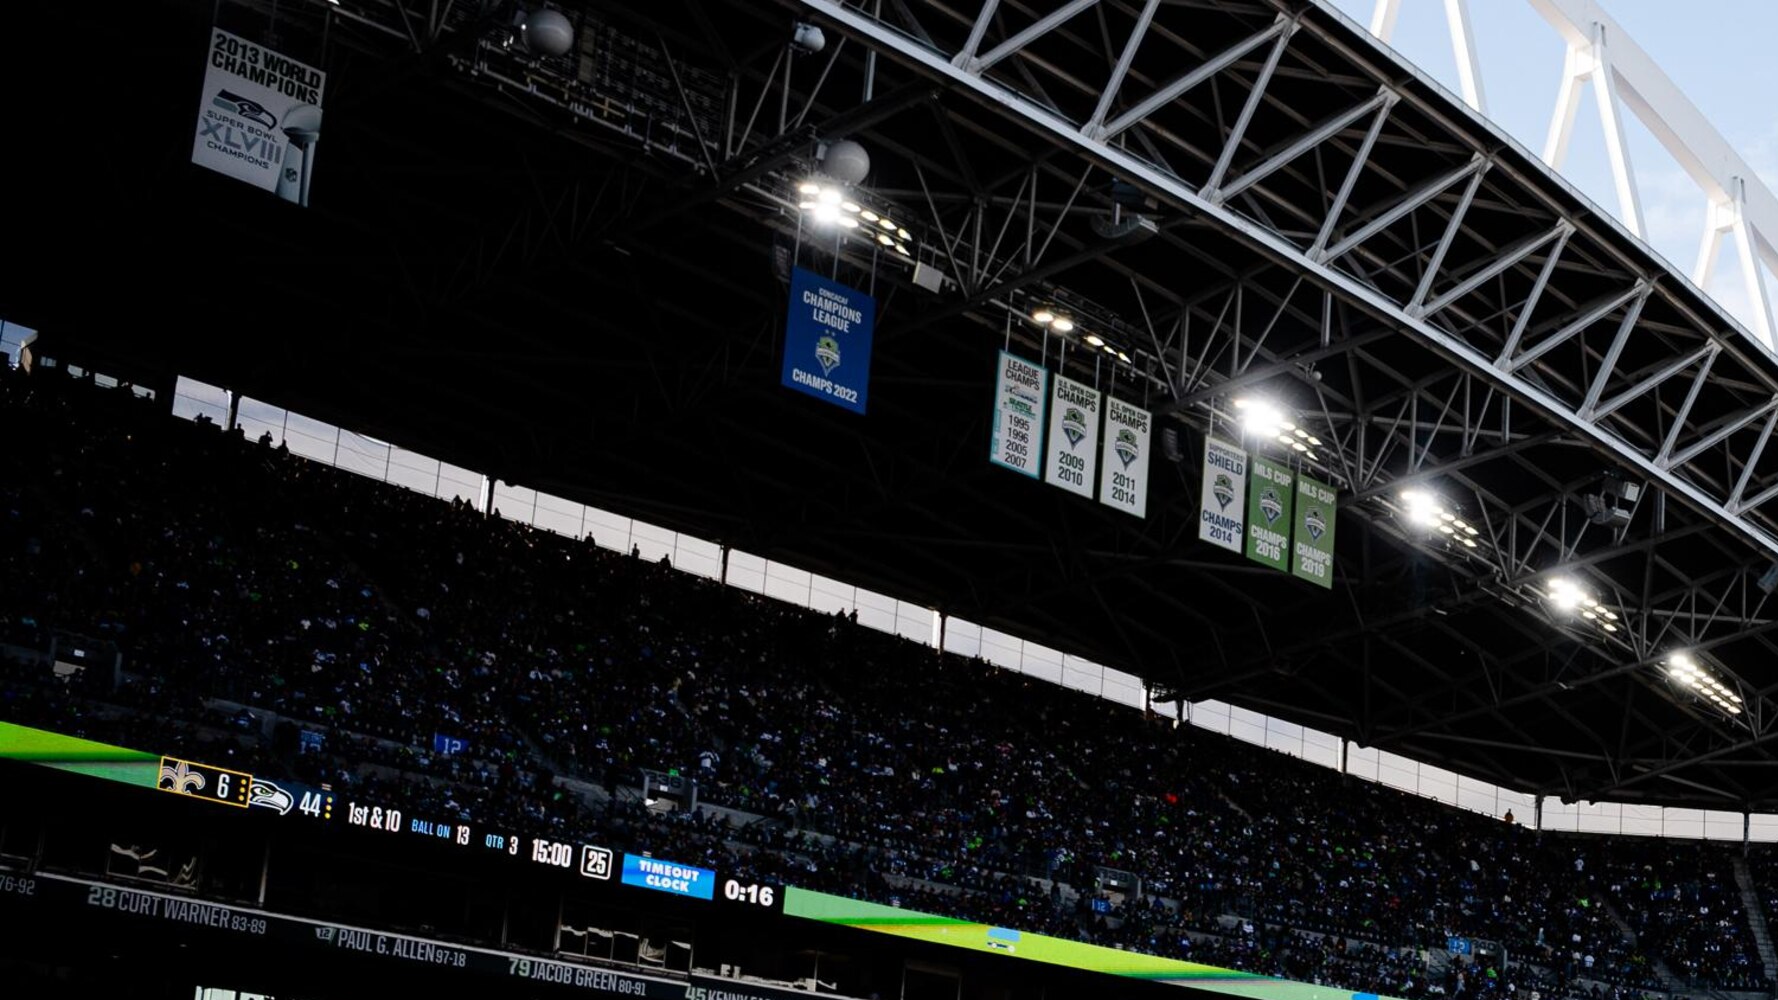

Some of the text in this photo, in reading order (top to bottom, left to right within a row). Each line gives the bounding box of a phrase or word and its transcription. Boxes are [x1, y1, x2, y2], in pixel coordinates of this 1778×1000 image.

[214, 33, 321, 89] 2013 WORLD
[212, 51, 318, 105] CHAMPIONS
[206, 110, 278, 143] SUPER BOWL
[200, 117, 281, 164] XLVIII
[207, 141, 269, 169] CHAMPIONS
[803, 290, 862, 324] CHAMPIONS
[813, 308, 850, 333] LEAGUE
[1005, 369, 1040, 391] CHAMPS
[1008, 359, 1039, 380] LEAGUE
[792, 367, 858, 403] CHAMPS 2022
[1057, 387, 1096, 413] CHAMPS
[1008, 415, 1030, 431] 1995
[1109, 408, 1148, 434] CHAMPS
[1006, 439, 1028, 457] 2005
[1007, 427, 1029, 444] 1996
[1004, 452, 1027, 469] 2007
[1058, 451, 1085, 472] 2009
[1208, 451, 1243, 476] SHIELD
[1057, 466, 1083, 487] 2010
[1113, 471, 1136, 491] 2011
[1254, 462, 1291, 487] MLS CUP
[1112, 486, 1136, 505] 2014
[1299, 481, 1335, 505] MLS CUP
[1202, 510, 1242, 535] CHAMPS
[1210, 526, 1232, 544] 2014
[1251, 525, 1287, 549] CHAMPS
[1256, 540, 1281, 562] 2016
[1297, 542, 1332, 567] CHAMPS
[1301, 557, 1325, 578] 2019
[443, 738, 461, 754] 12
[217, 774, 229, 799] 6
[299, 791, 321, 818] 44
[348, 802, 401, 833] 1st & 10
[411, 818, 470, 847] BALL ON 13
[485, 833, 518, 856] QTR 3
[532, 839, 571, 868] 15:00
[587, 850, 607, 876] 25
[639, 860, 700, 883] TIMEOUT
[645, 874, 689, 894] CLOCK
[724, 879, 773, 907] 0:16
[88, 886, 267, 935] 28 CURT WARNER 83-89
[338, 931, 467, 968] PAUL G. ALLEN 97-18
[508, 957, 647, 997] 79 JACOB GREEN 80-91
